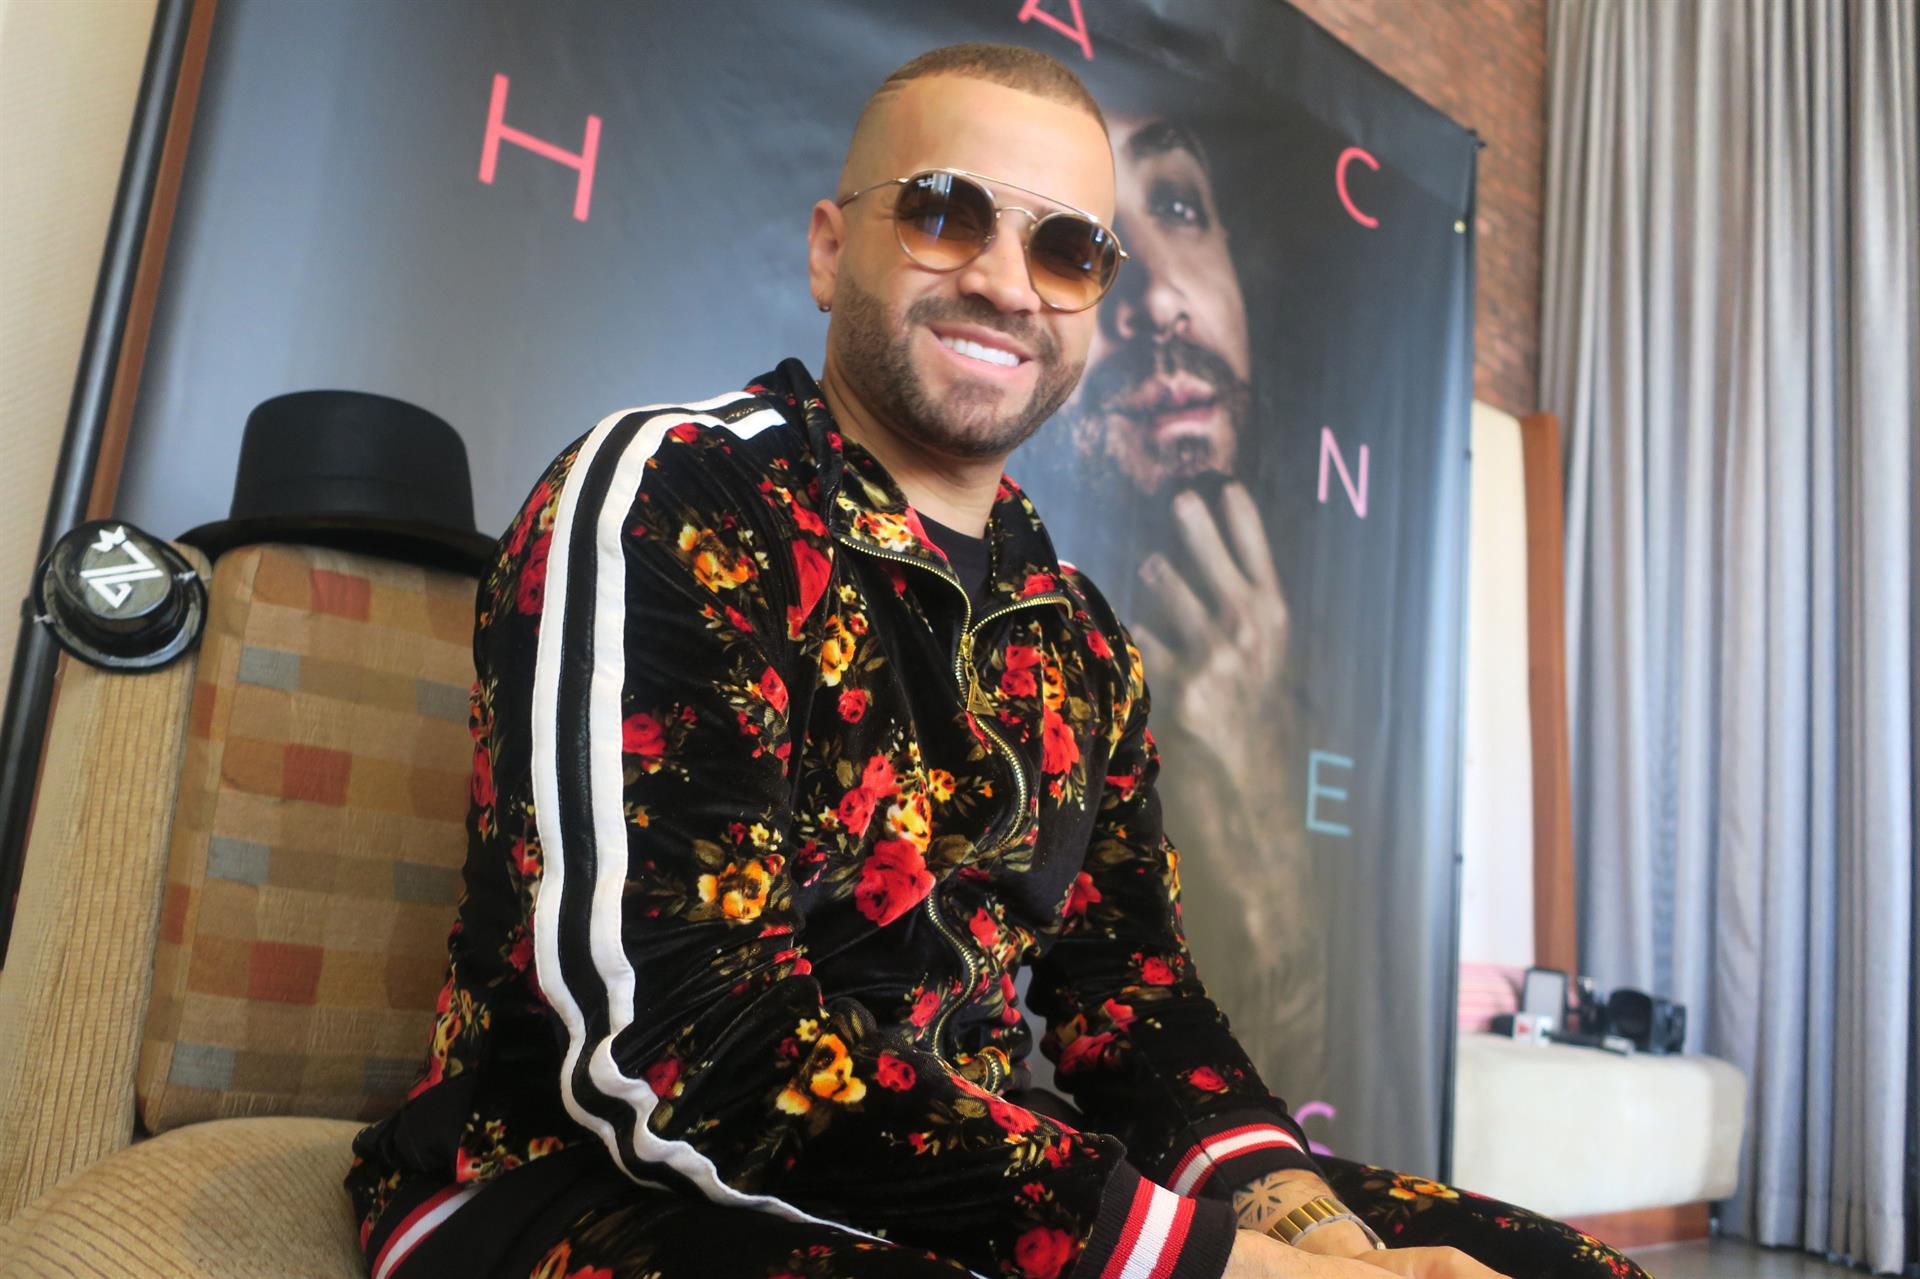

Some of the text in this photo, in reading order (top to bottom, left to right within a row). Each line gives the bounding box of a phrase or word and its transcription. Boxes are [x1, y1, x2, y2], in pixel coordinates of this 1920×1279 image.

[478, 73, 604, 223] H
[1335, 147, 1381, 230] C
[1318, 426, 1370, 519] N
[1306, 750, 1355, 837] E
